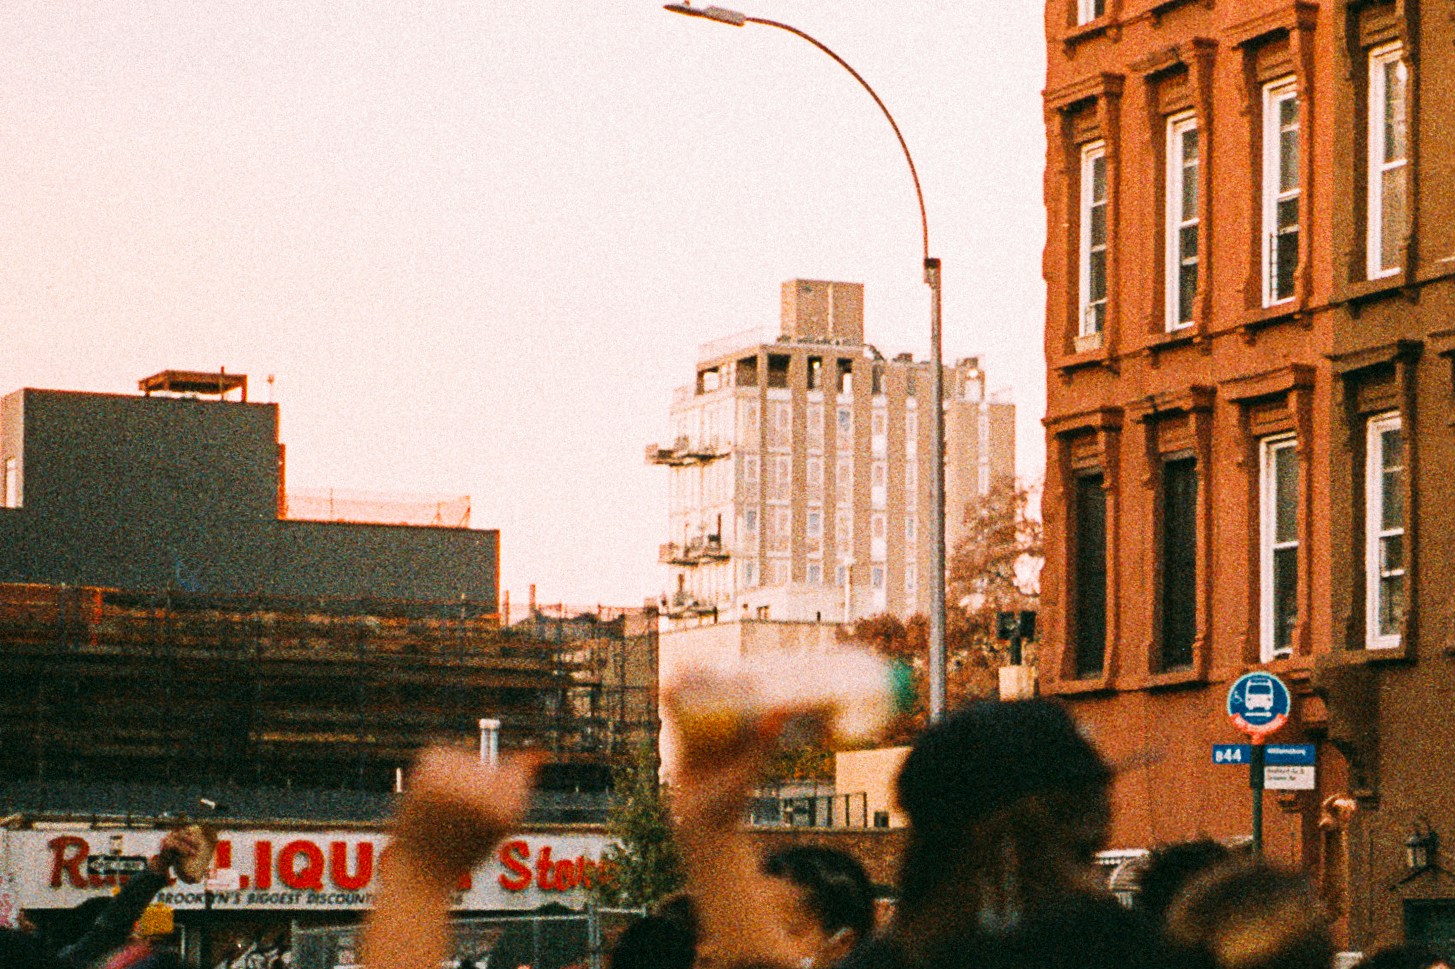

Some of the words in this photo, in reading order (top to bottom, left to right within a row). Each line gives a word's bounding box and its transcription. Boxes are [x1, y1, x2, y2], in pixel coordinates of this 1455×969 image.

[1215, 748, 1242, 762] B44
[216, 839, 472, 891] LIQU
[247, 890, 301, 905] BIGGEST
